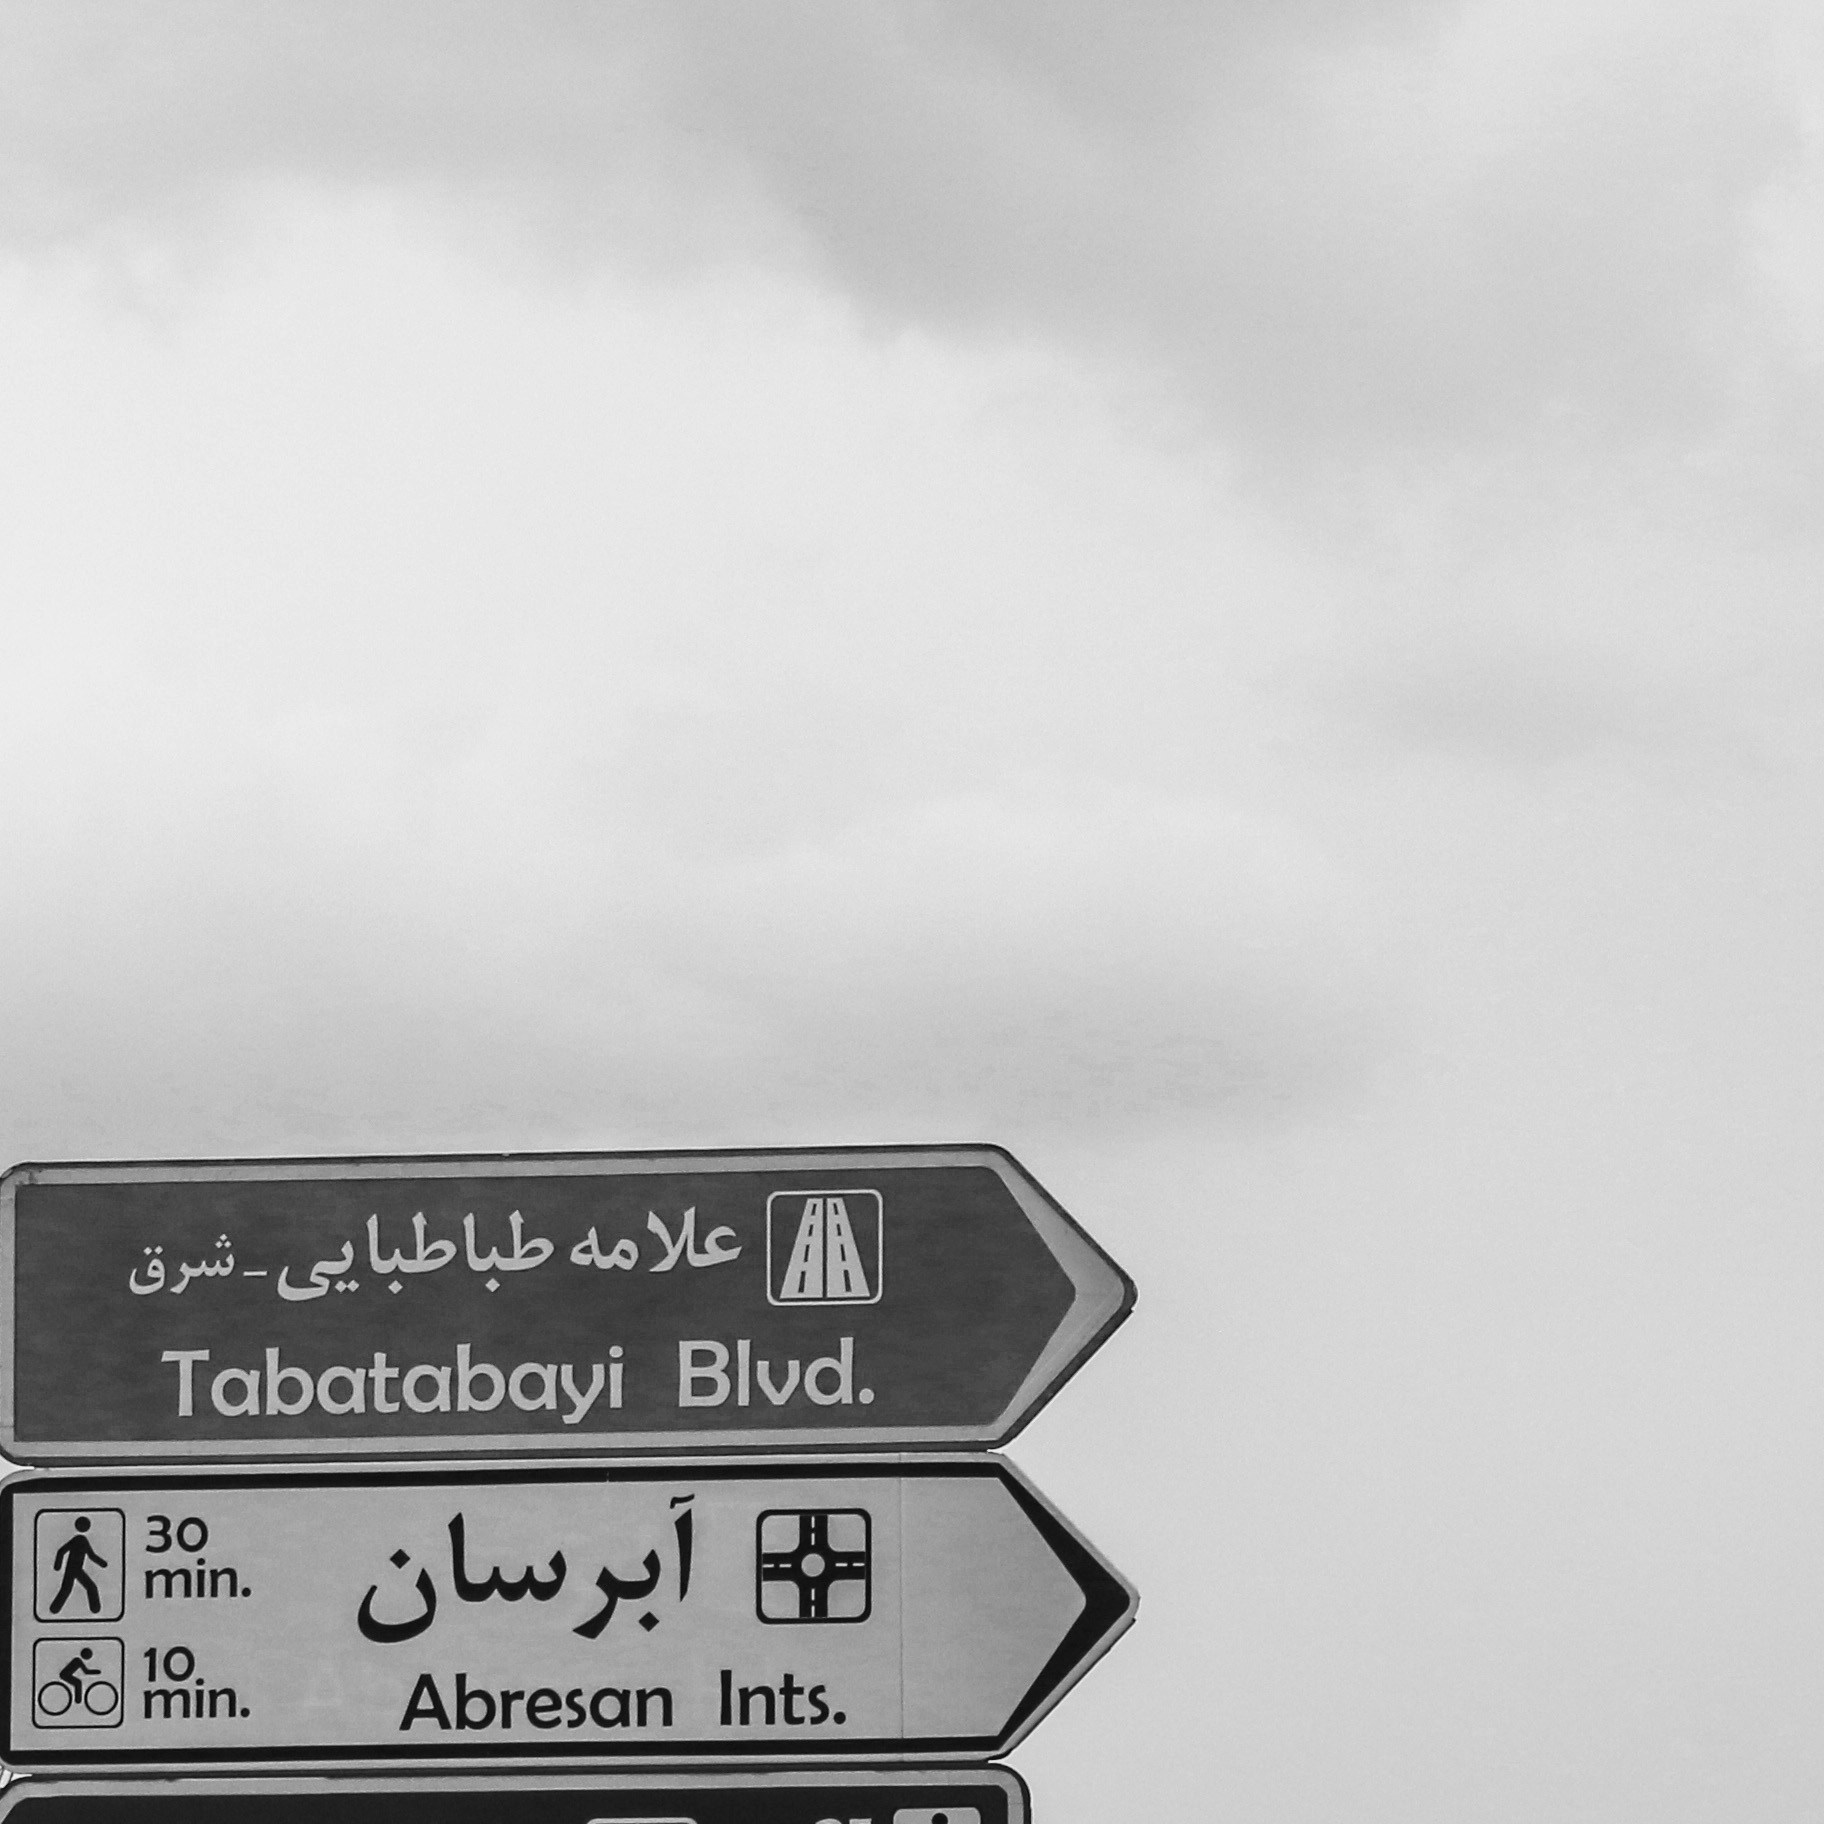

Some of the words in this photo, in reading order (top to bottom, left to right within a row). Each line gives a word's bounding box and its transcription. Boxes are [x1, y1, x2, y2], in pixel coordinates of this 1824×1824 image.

[129, 1233, 234, 1294] شرق
[278, 1210, 553, 1300] طباطبایی
[570, 1207, 741, 1271] علامه
[162, 1344, 622, 1424] Tabatabayi
[679, 1337, 874, 1407] Blvd.
[146, 1515, 208, 1553] 30
[145, 1558, 251, 1598] min.
[144, 1646, 195, 1682] 10
[144, 1678, 250, 1718] min.
[400, 1673, 672, 1730] Abresan
[721, 1670, 846, 1725] Ints.
